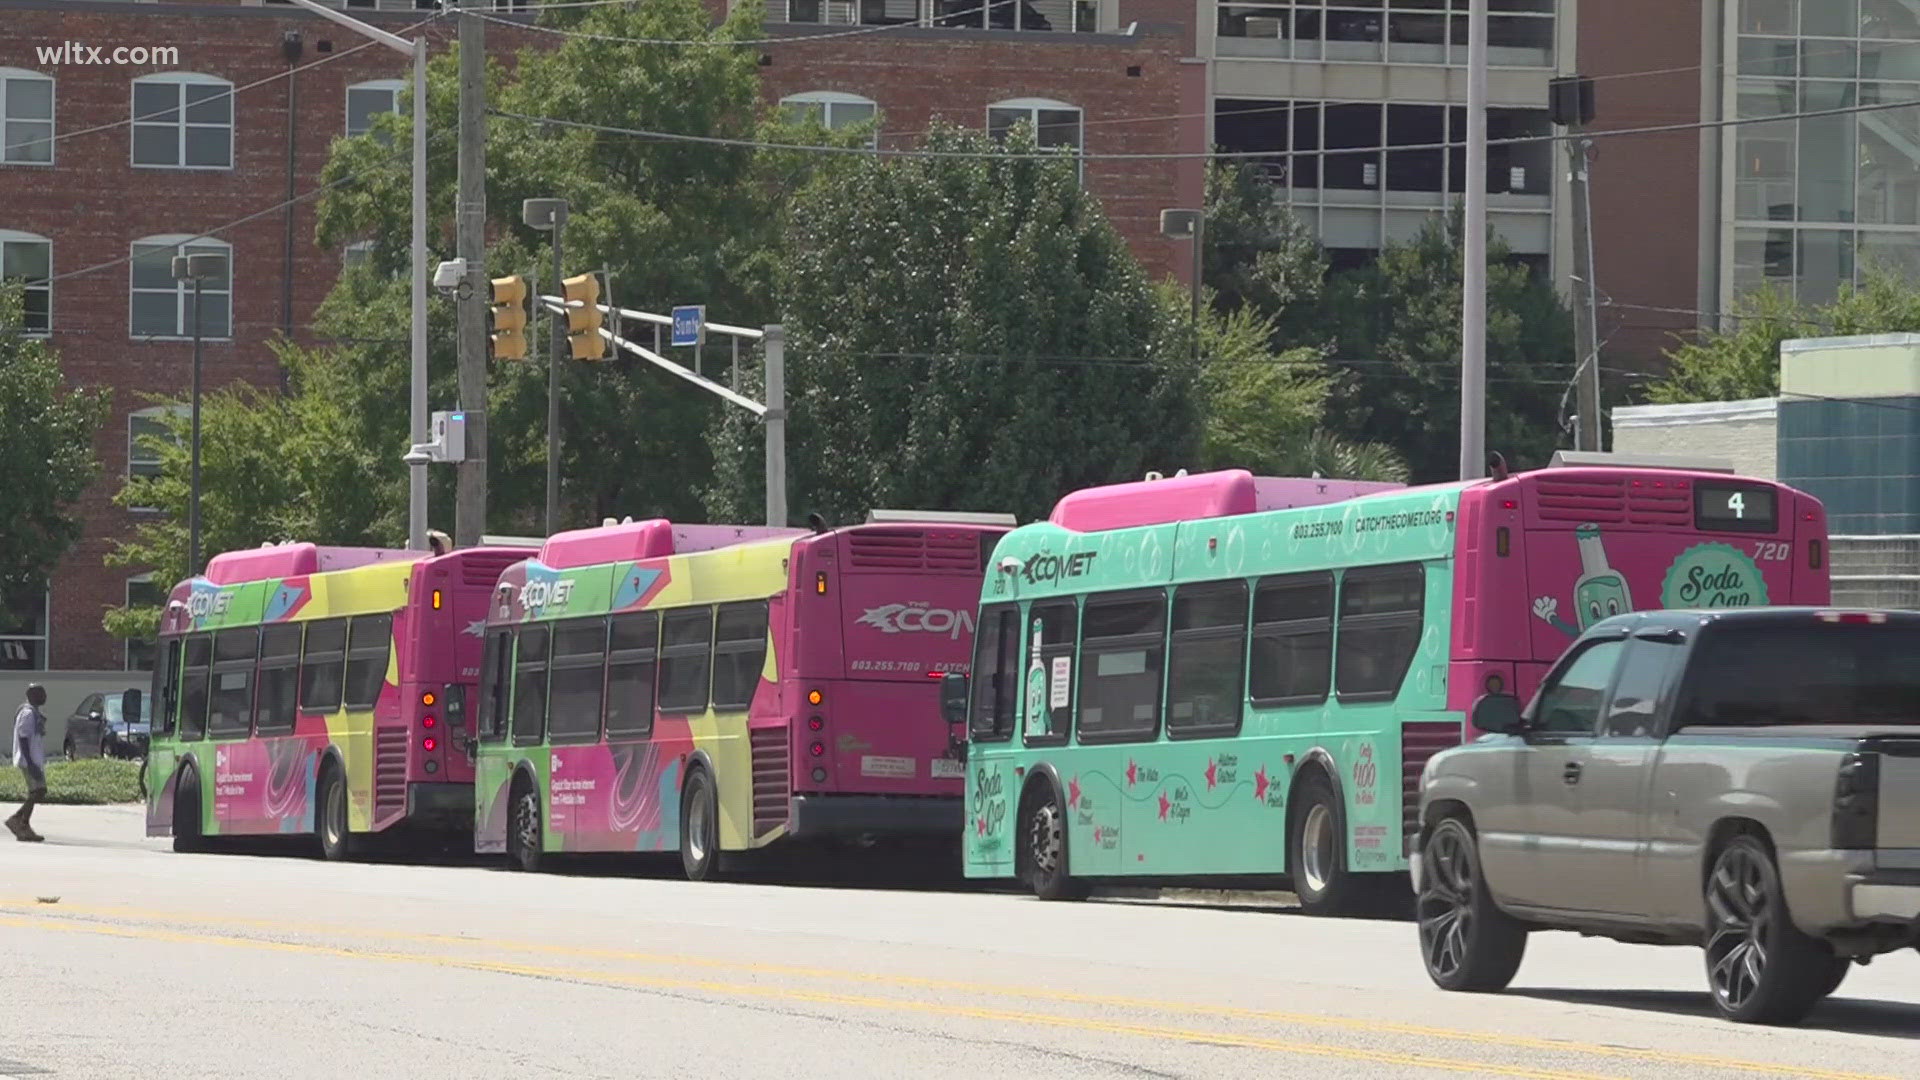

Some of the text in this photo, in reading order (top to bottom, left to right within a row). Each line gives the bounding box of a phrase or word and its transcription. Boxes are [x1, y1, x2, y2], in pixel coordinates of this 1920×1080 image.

[1727, 492, 1745, 519] 4
[1293, 510, 1442, 539] 803.255.7100 CATCHTHECOMET.ORG
[1034, 550, 1097, 588] COMET
[1753, 542, 1790, 561] 720
[525, 579, 576, 614] COMET
[1679, 563, 1744, 602] Soda
[851, 659, 921, 672] 803.255.7100
[974, 763, 1003, 814] Soda
[986, 799, 1006, 836] Cap
